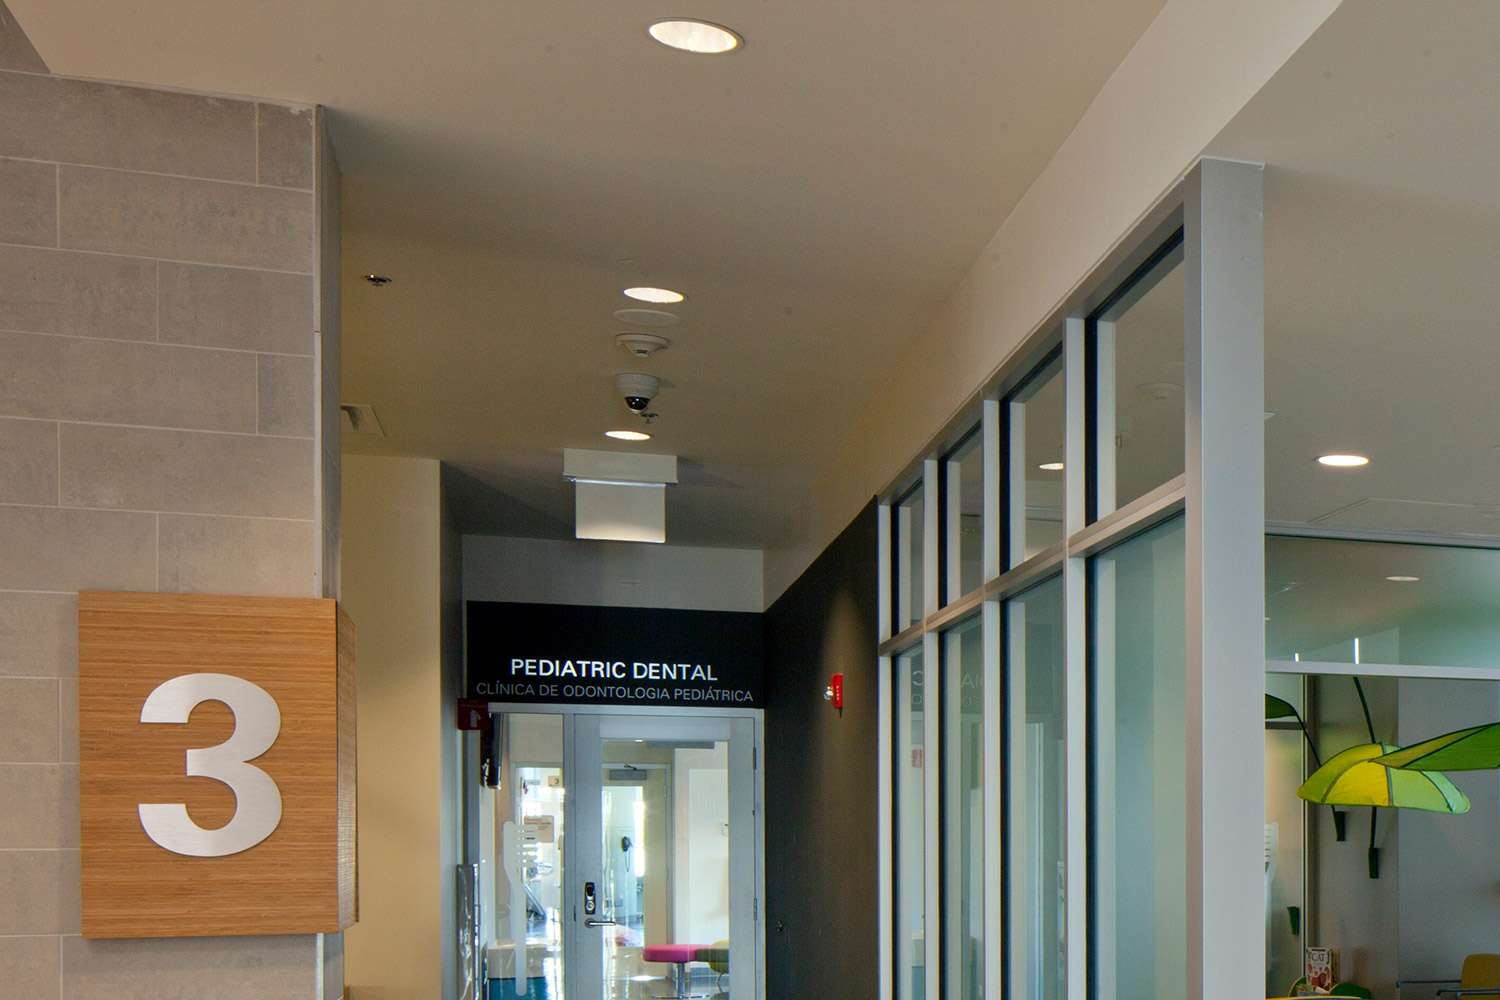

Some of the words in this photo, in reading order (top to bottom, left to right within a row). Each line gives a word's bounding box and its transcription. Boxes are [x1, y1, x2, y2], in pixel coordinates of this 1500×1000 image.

[511, 658, 627, 679] PEDIATRIC
[632, 662, 718, 681] DENTAL
[476, 680, 535, 696] CLÍNICA
[539, 684, 559, 697] DE
[563, 684, 671, 700] ODONTOLOGIA
[674, 686, 754, 702] PEDIÁTRICA
[138, 672, 282, 857] 3
[1311, 953, 1325, 961] CAT
